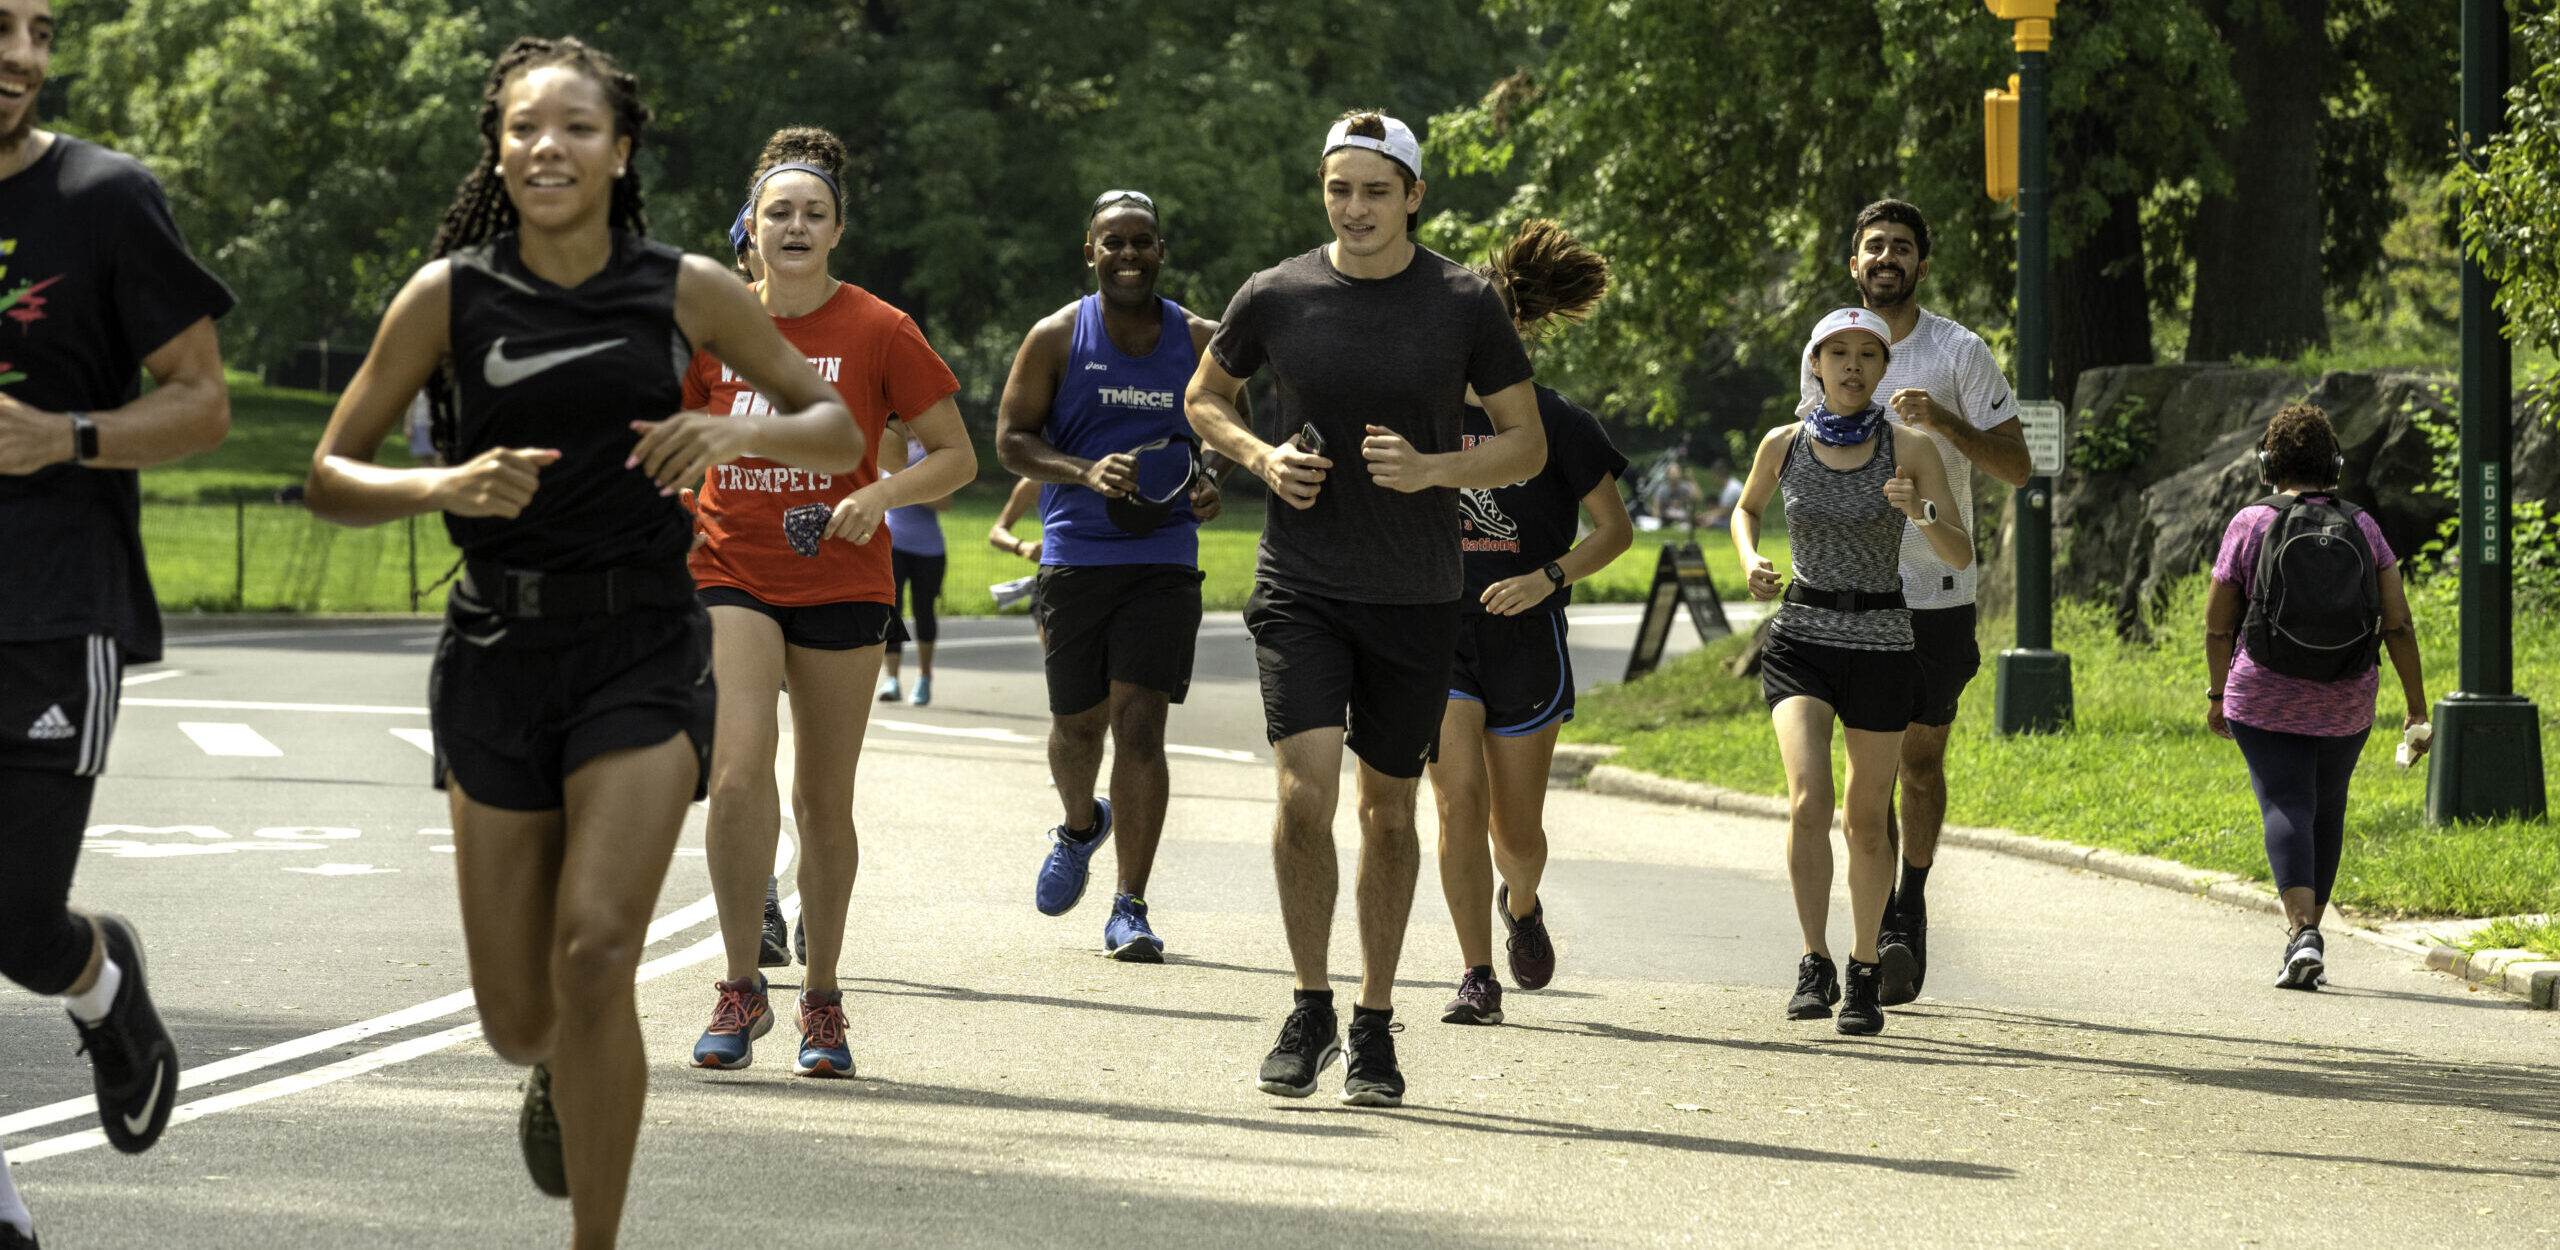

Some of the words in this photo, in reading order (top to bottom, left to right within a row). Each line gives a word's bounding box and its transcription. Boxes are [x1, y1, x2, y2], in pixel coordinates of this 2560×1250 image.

[717, 464, 832, 493] TRUMPETS
[2484, 465, 2496, 561] E0206
[1462, 537, 1520, 553] tational
